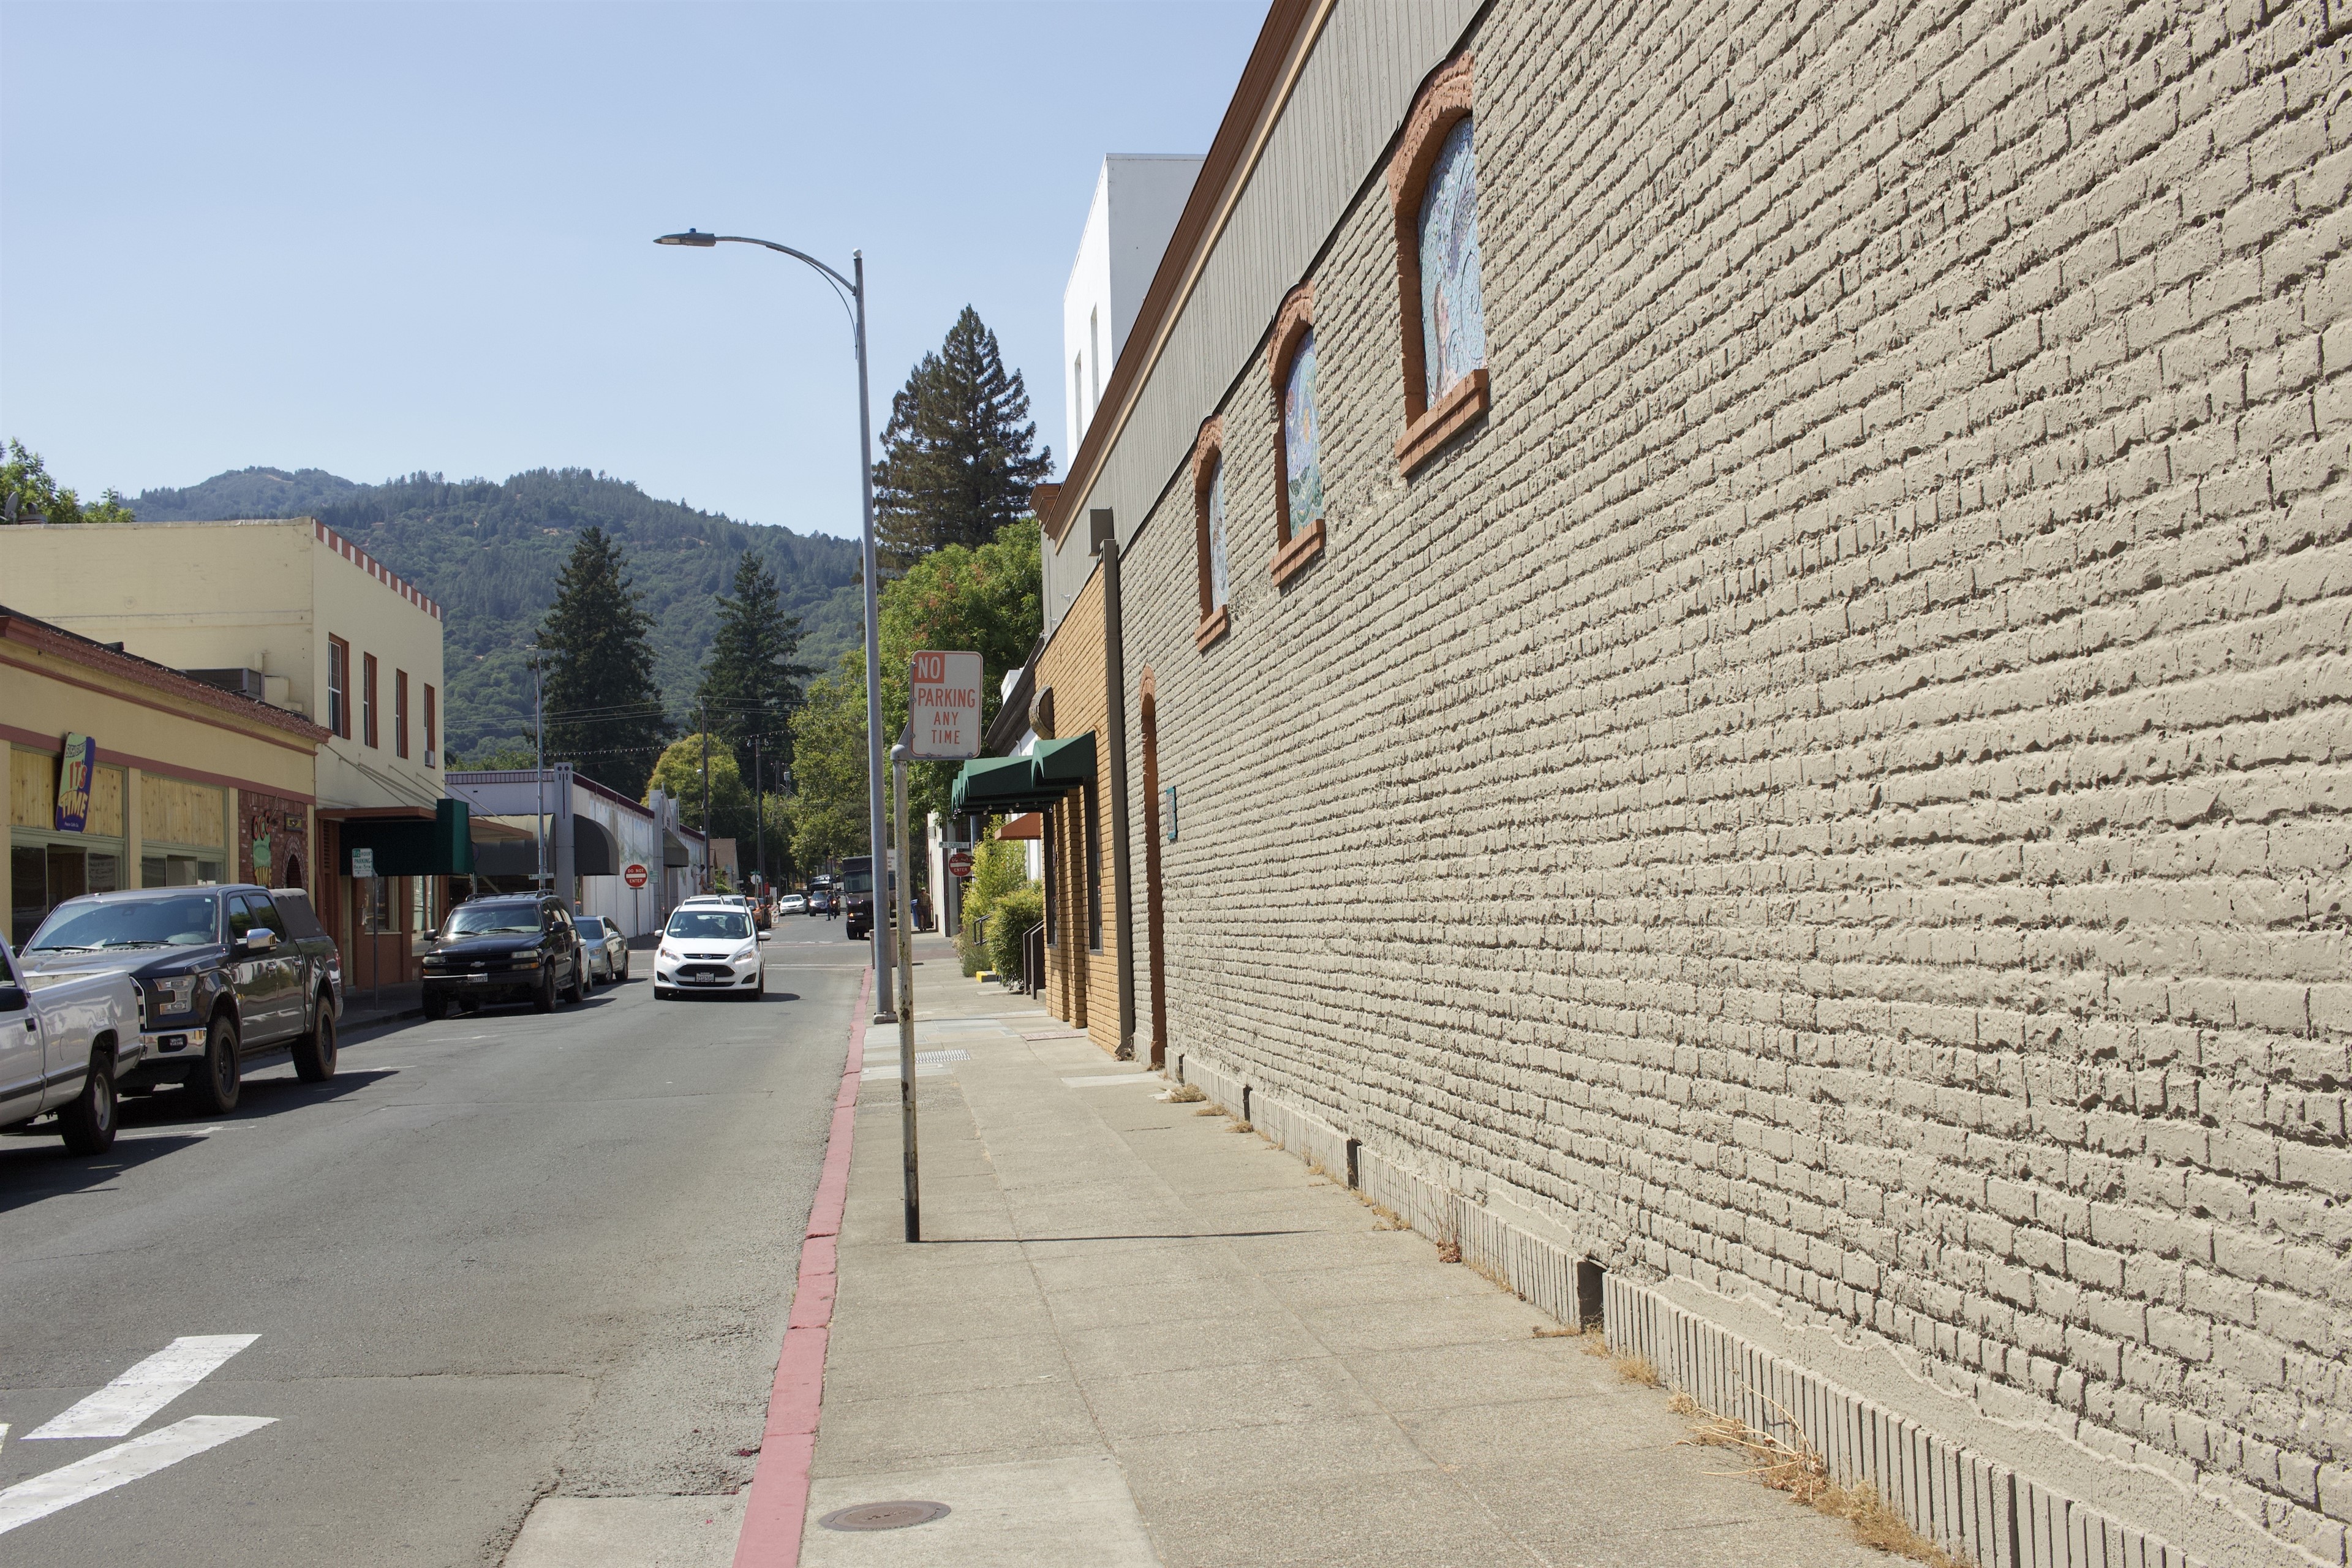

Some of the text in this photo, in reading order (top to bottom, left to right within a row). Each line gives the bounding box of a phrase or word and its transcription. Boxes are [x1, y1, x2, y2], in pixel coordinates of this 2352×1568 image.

[918, 657, 941, 679] NO
[918, 688, 976, 708] PARKING
[933, 711, 959, 726] ANY
[932, 729, 960, 744] TIME
[61, 790, 88, 819] TIME
[255, 865, 271, 888] TIME
